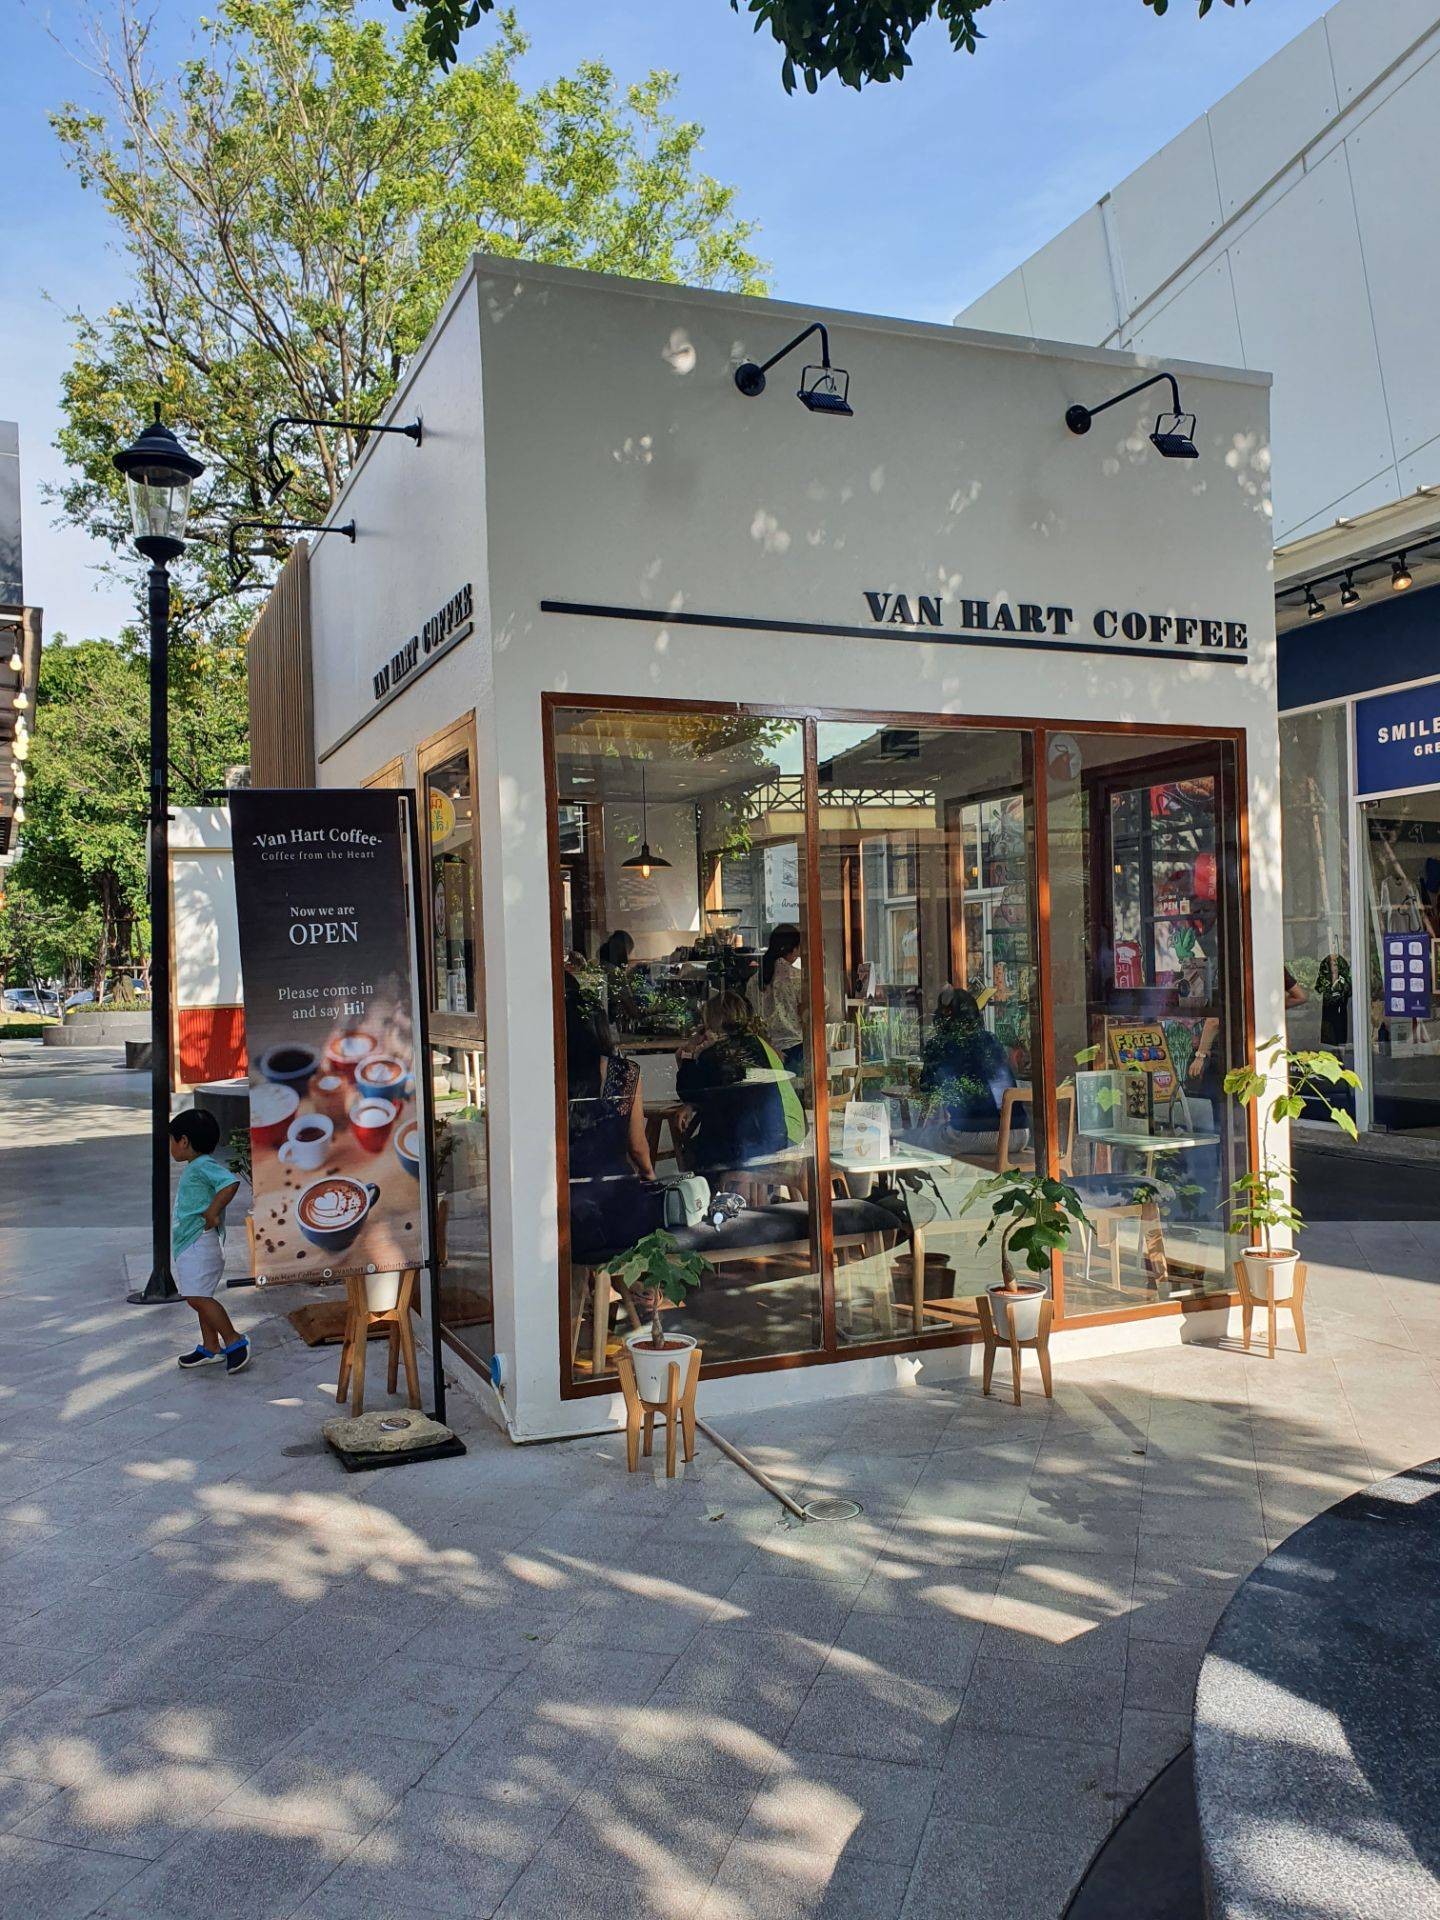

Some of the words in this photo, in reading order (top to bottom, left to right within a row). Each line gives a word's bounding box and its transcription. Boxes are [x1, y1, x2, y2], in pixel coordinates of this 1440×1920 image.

[862, 591, 944, 627] VAN
[960, 599, 1074, 635] HART
[1093, 609, 1249, 649] COFFEE
[390, 635, 419, 684] HART
[421, 583, 474, 654] COFFEE
[290, 829, 325, 844] Hart
[261, 851, 296, 861] Coffee
[299, 850, 323, 860] from
[327, 850, 343, 859] the
[347, 850, 375, 859] Heart
[319, 906, 335, 916] we
[289, 922, 359, 946] OPEN
[278, 986, 319, 1001] Please
[322, 986, 357, 998] come
[360, 983, 374, 995] in
[292, 1004, 316, 1020] and
[320, 1006, 340, 1019] say
[343, 1002, 365, 1016] Hi!
[1115, 1032, 1163, 1049] FRIED
